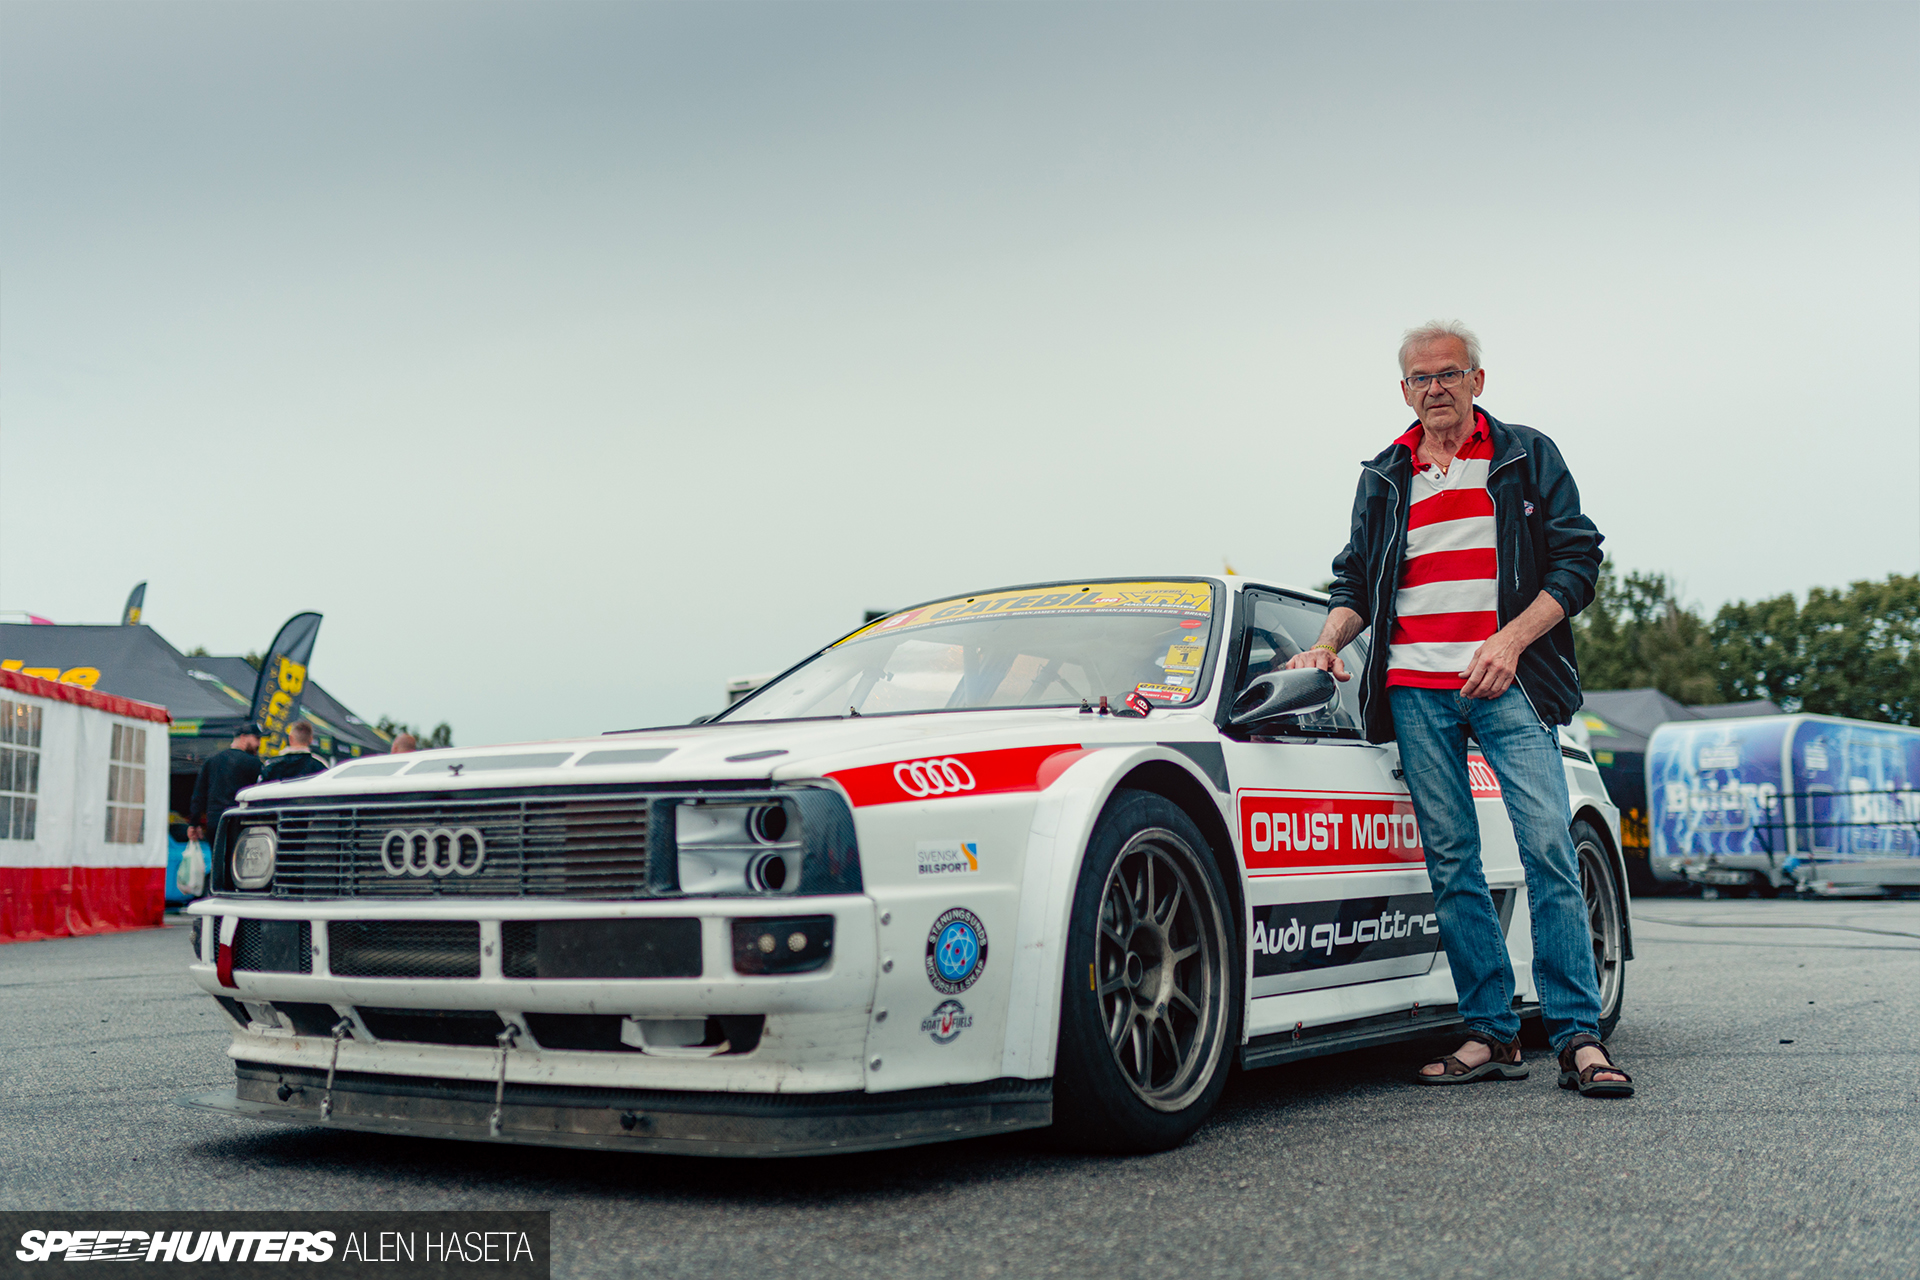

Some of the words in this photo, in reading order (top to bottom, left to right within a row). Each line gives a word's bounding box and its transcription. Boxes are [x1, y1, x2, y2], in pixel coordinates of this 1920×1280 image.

[929, 592, 1103, 619] GATEBIL
[1250, 812, 1344, 852] ORUST
[1351, 813, 1423, 850] MOTO
[918, 850, 959, 862] SVENSK
[918, 862, 968, 874] BILSPORT
[928, 909, 987, 946] STENUNGSUNDS
[1252, 917, 1307, 955] Audi
[1310, 910, 1440, 956] quattro
[921, 1019, 941, 1031] GOAT
[952, 1016, 973, 1029] FUELS
